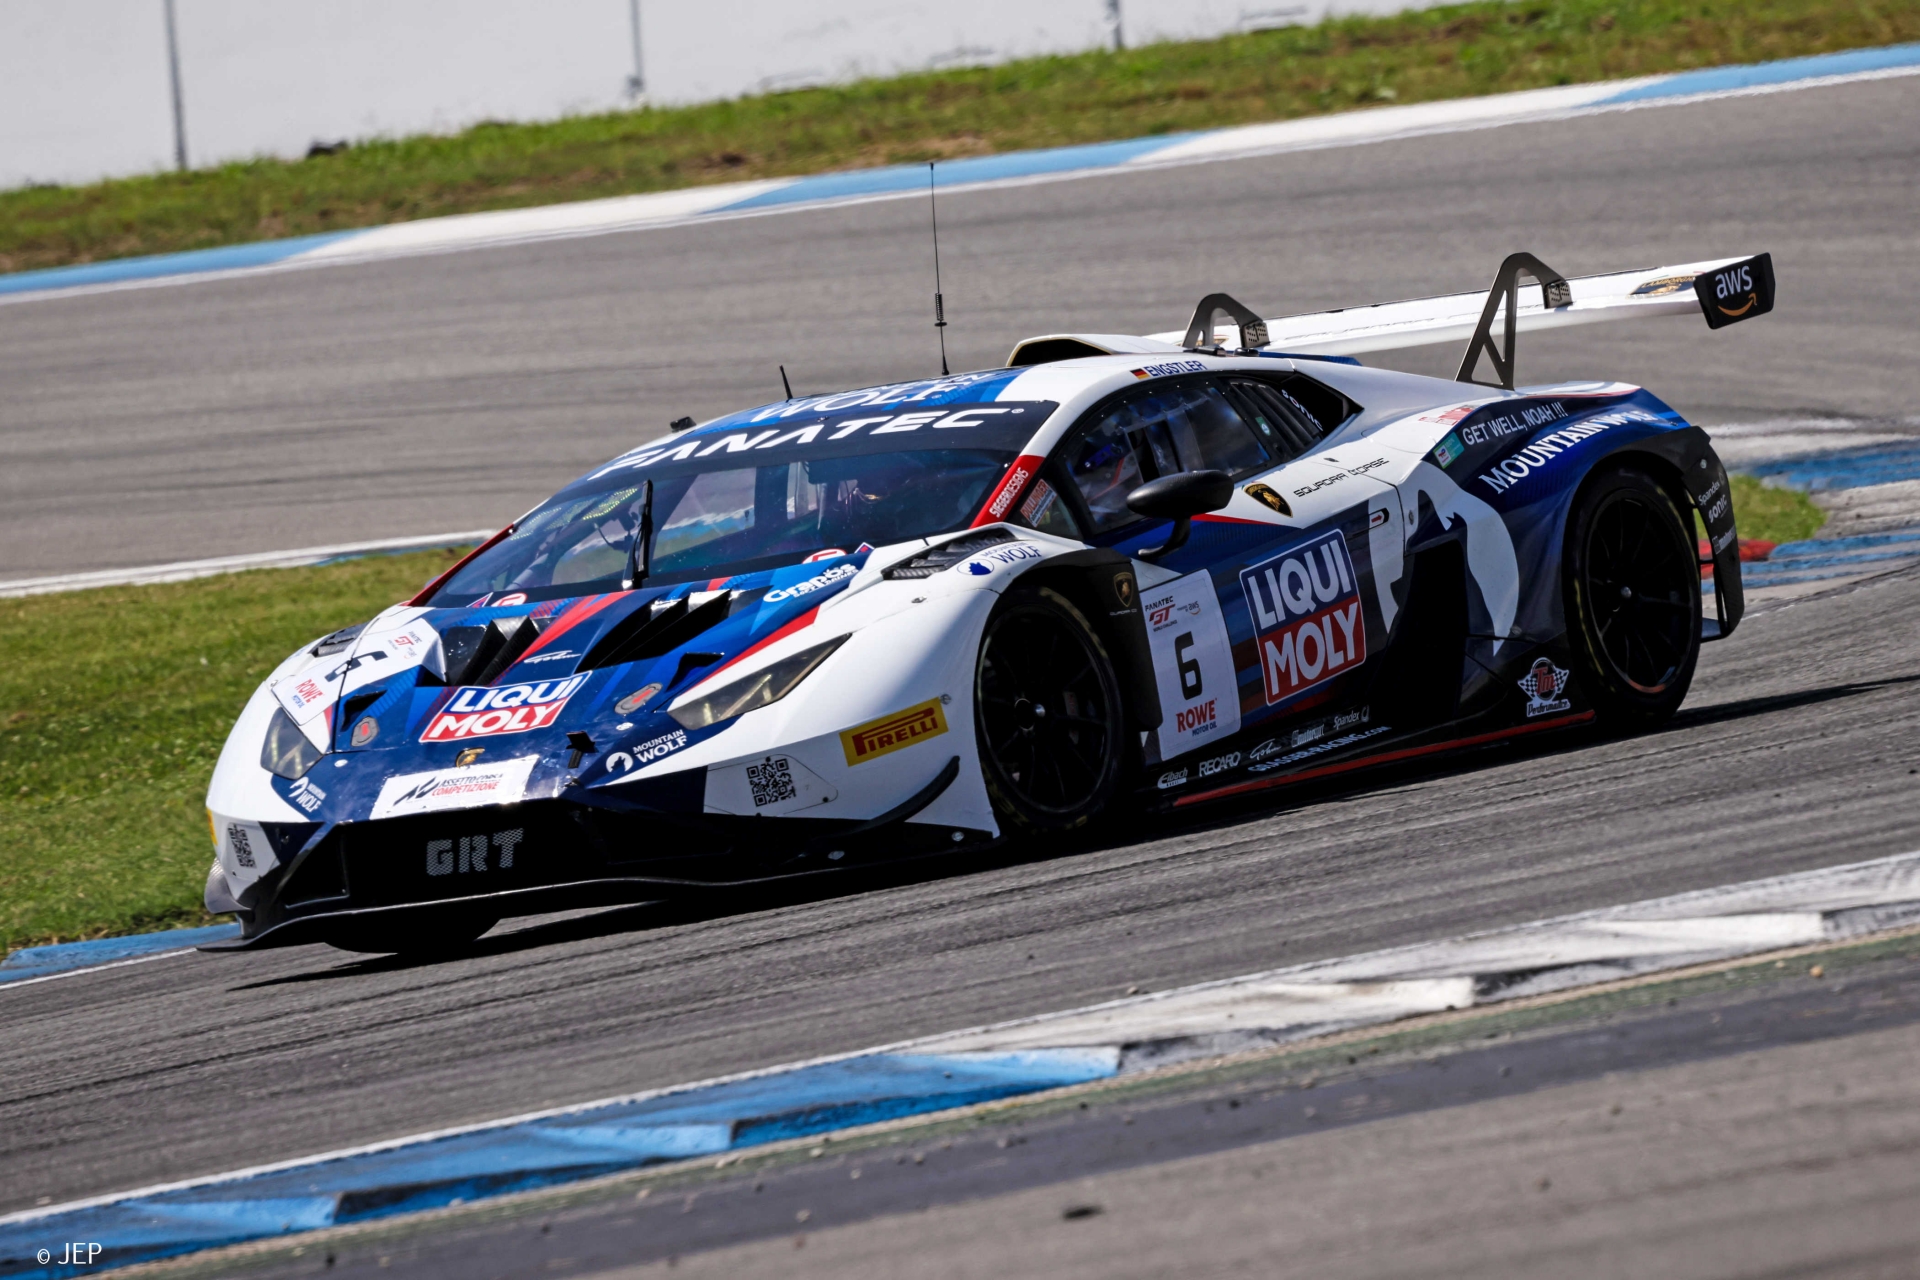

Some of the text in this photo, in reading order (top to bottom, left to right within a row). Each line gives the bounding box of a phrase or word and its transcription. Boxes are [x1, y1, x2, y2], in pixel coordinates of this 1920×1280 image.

[1715, 265, 1753, 299] aws
[1143, 360, 1209, 377] ENGSTLER
[1281, 389, 1324, 431] sonic
[1462, 423, 1490, 446] GET
[1487, 411, 1529, 438] WELL,
[1524, 404, 1557, 430] NOAH
[1551, 401, 1569, 418] !!!
[1293, 472, 1348, 498] SQUADRA
[1348, 457, 1390, 476] CORSE
[1709, 494, 1728, 523] sonic
[991, 545, 1042, 564] WOLF
[1247, 539, 1352, 630] LIQUI
[1144, 595, 1174, 612] FANATEC
[1149, 603, 1176, 626] GT
[1264, 601, 1359, 696] MOLY
[1175, 631, 1203, 701] 6
[450, 675, 584, 712] LIQUI
[428, 699, 566, 738] MOLY
[851, 706, 939, 757] PIRELLI
[1175, 700, 1216, 733] ROWE
[1192, 721, 1218, 737] MOTOR OIL
[1333, 711, 1361, 730] Spandex
[632, 729, 685, 754] MOUNTAIN
[635, 735, 688, 763] WOLF
[1157, 767, 1189, 789] Eibach
[1199, 752, 1242, 777] RECARO
[296, 790, 322, 813] WOLF
[426, 828, 524, 876] GRT
